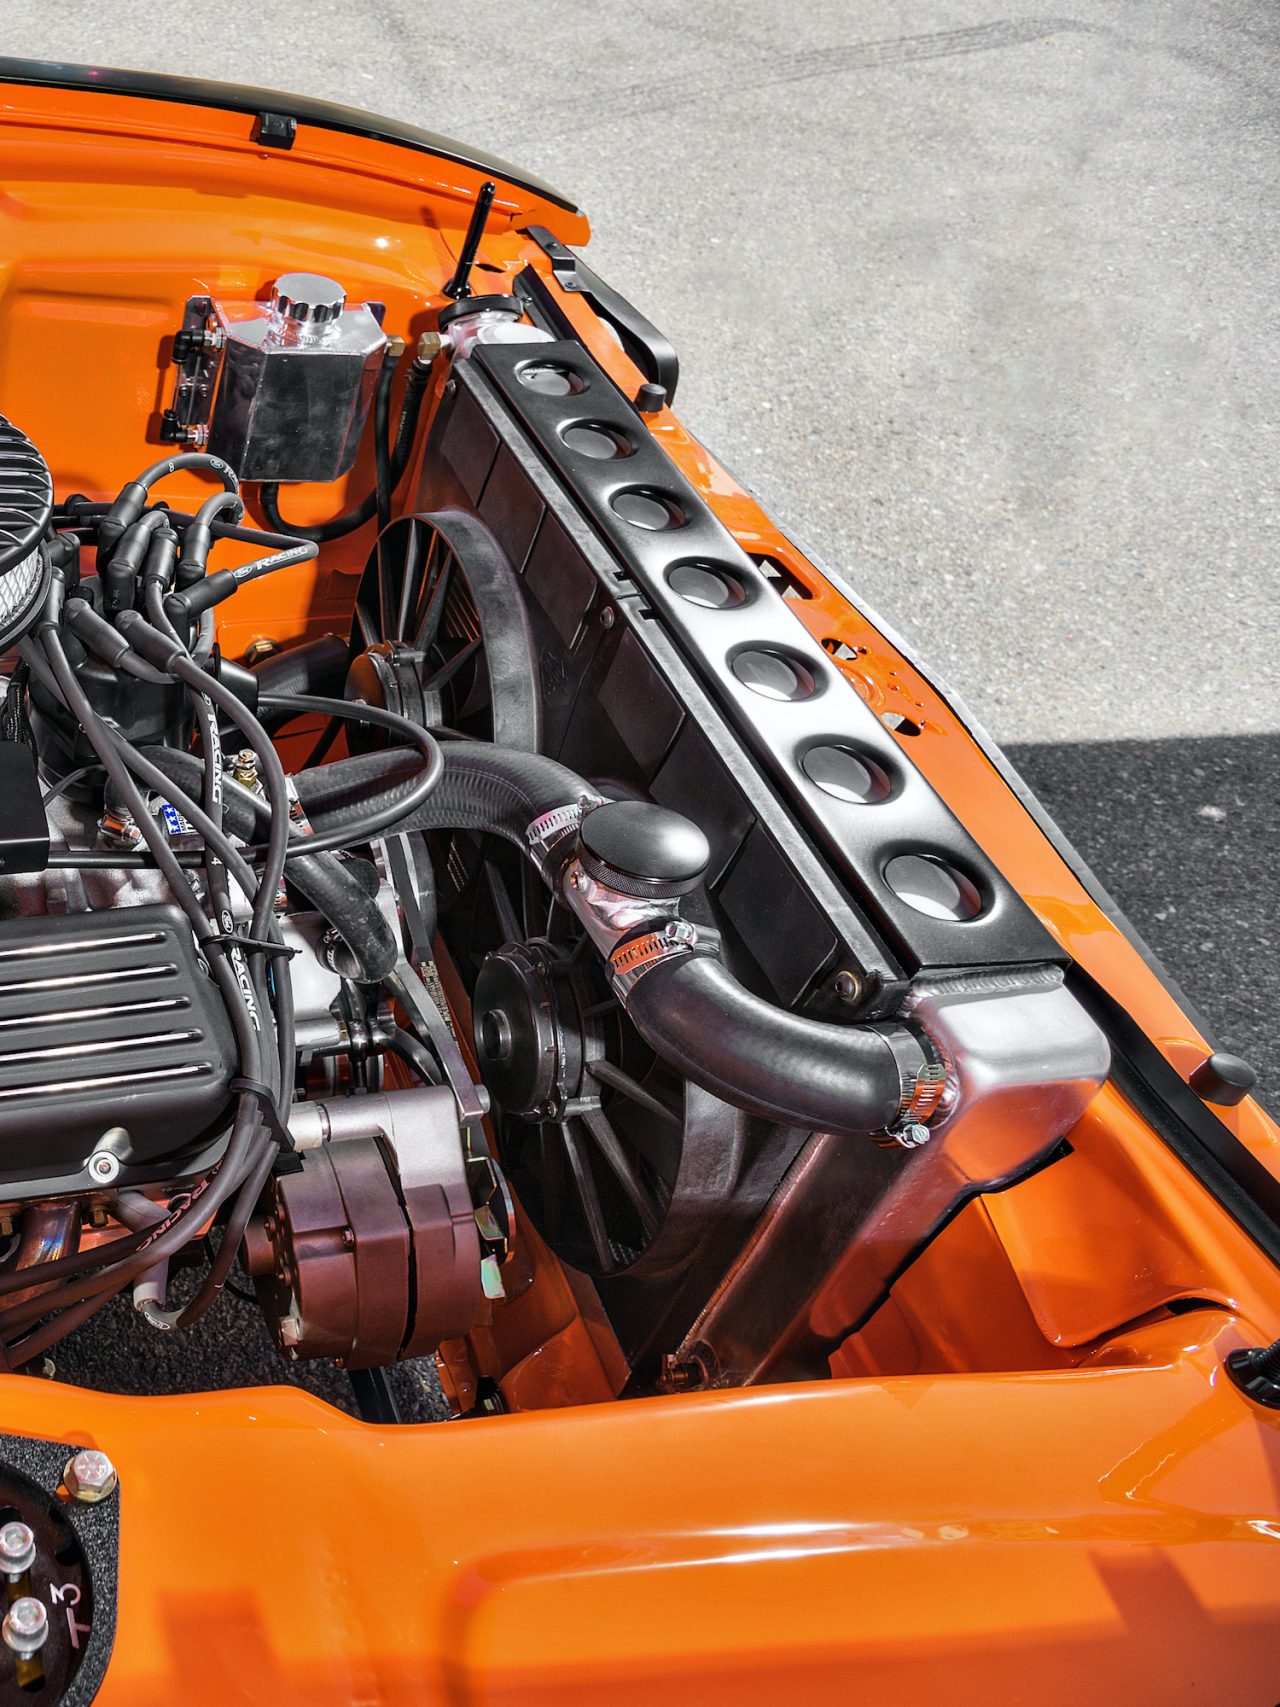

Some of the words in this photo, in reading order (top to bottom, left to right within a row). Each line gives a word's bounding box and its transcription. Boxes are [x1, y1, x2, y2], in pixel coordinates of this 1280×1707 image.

[169, 462, 175, 472] 8
[255, 547, 308, 570] RACING
[207, 713, 222, 805] RACING
[211, 857, 222, 866] 4
[231, 947, 261, 1032] RACING
[136, 1179, 211, 1252] RACING
[49, 1582, 91, 1650] T3
